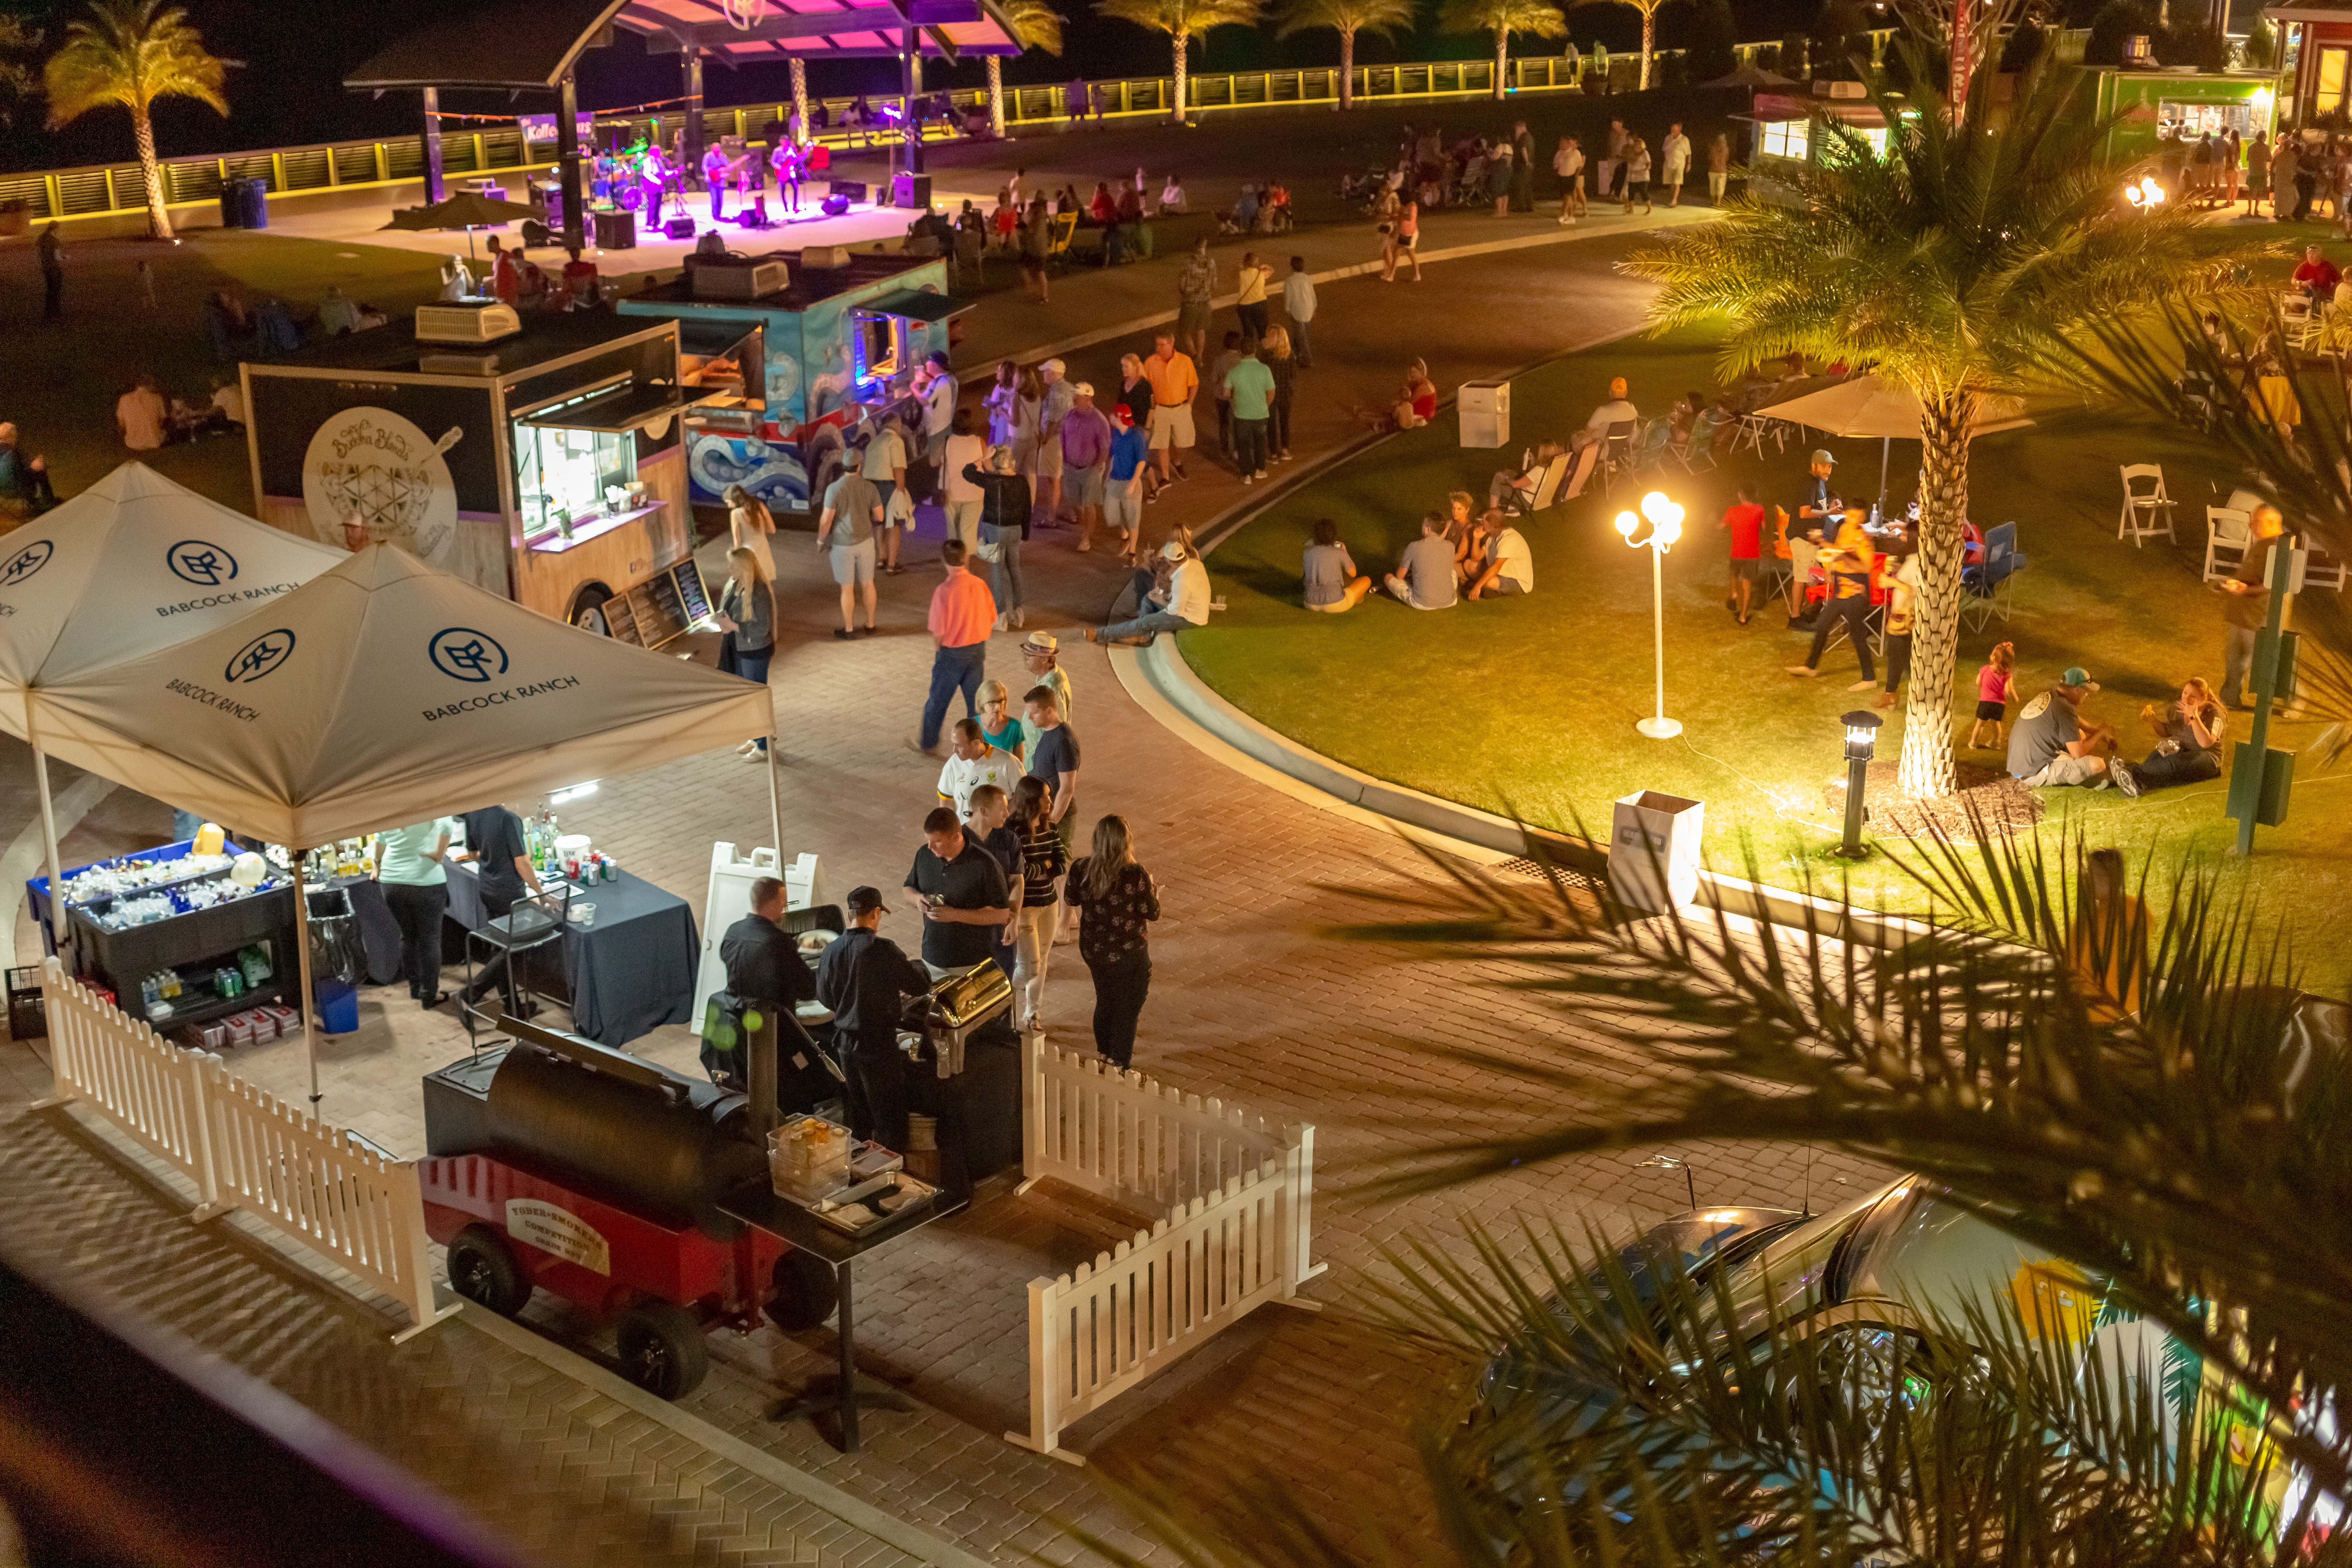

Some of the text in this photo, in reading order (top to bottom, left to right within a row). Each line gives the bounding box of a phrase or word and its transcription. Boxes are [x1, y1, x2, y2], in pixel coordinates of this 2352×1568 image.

[156, 581, 299, 617] BABCOCK RANCH
[166, 678, 262, 722] BABCOCK RANCH
[422, 676, 580, 722] BABCOCK RANCH
[511, 1207, 546, 1217] YODER
[525, 1220, 589, 1252] COMPETITION
